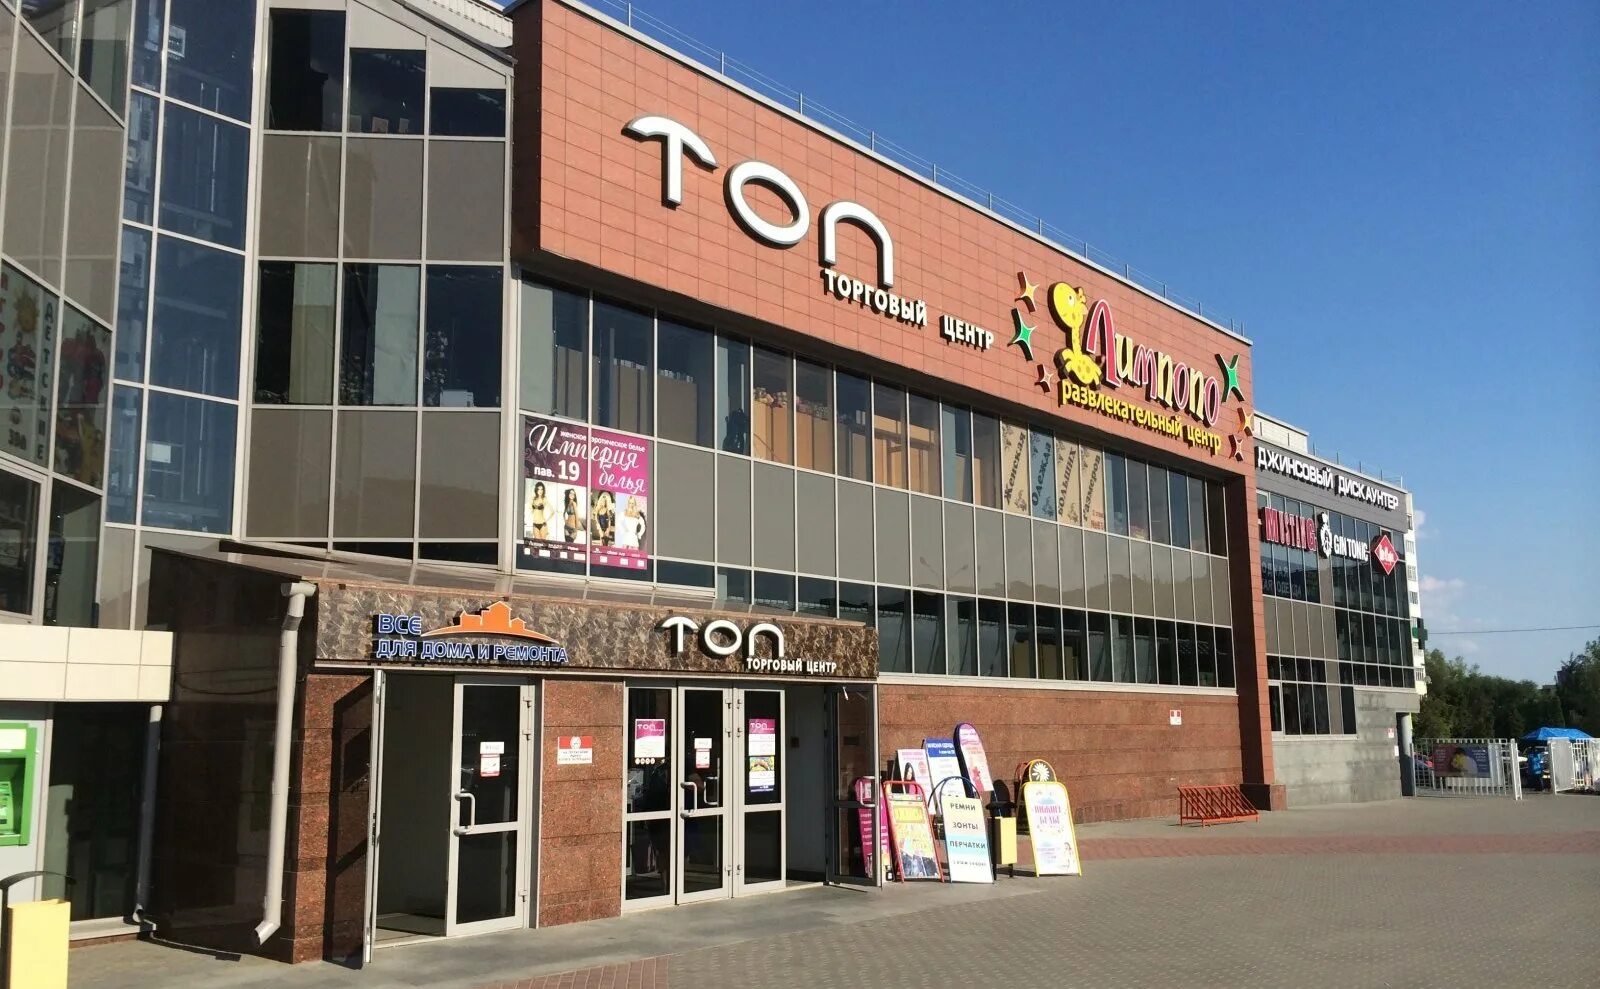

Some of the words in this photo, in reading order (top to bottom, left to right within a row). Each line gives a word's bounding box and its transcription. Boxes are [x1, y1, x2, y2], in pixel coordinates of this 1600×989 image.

[625, 114, 894, 288] ТОП
[824, 267, 928, 327] ТОРГОВЫЙ
[942, 314, 995, 350] ЦЕНТР
[1086, 299, 1220, 427] Лимпопо
[1061, 379, 1183, 438] развлекательный
[1187, 424, 1222, 455] центр
[533, 466, 556, 478] пав.
[558, 459, 580, 481] 19
[599, 463, 646, 495] белья
[1257, 446, 1334, 489] ДЖИНСОВЫЙ
[1333, 534, 1347, 556] GIN
[1347, 538, 1369, 562] TONIC
[377, 613, 422, 636] ВСЕ
[661, 616, 785, 658] ТОП
[376, 639, 418, 659] ДЛЯ
[420, 641, 475, 660] ДОМА
[477, 644, 490, 660] И
[492, 645, 569, 663] РЕМОНТА
[746, 657, 803, 672] ТОРГОВЫЙ
[806, 660, 837, 675] ЦЕНТР
[950, 802, 976, 811] РЕМНИ
[952, 821, 979, 830] ЗОНТЫ
[949, 840, 987, 849] ПЕРЧАТКИ
